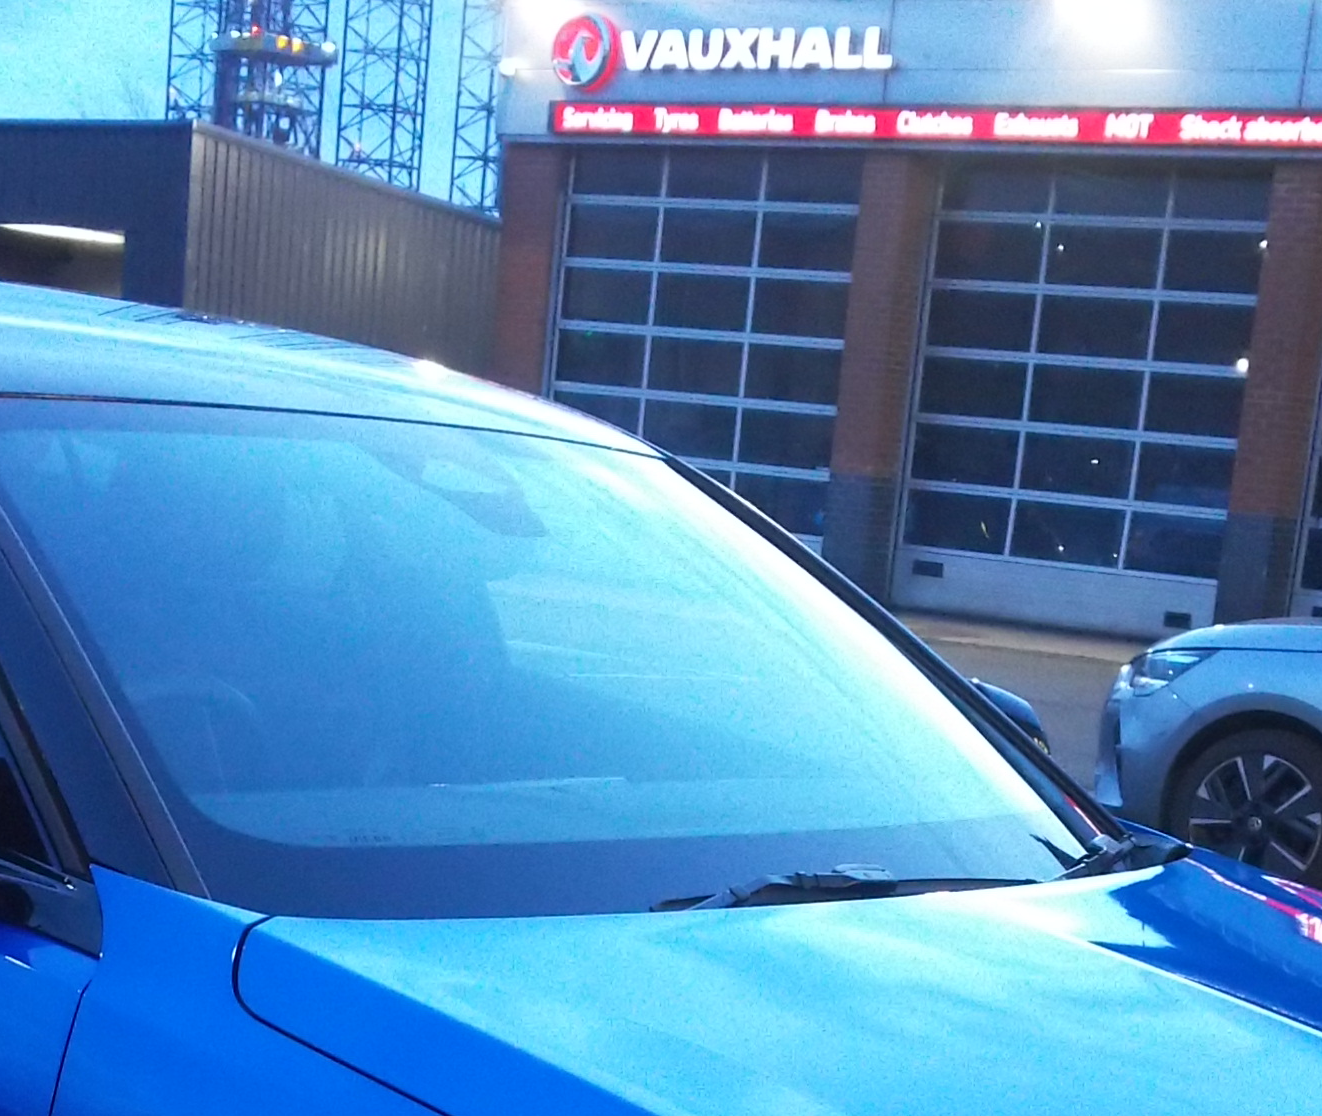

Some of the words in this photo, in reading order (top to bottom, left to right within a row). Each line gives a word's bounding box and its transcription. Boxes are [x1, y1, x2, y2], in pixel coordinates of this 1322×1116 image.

[621, 26, 893, 71] VAUXHALL
[563, 107, 633, 133] Servicing
[654, 107, 699, 133] Tyres
[717, 108, 794, 133] Batteries
[814, 109, 876, 134] Brakes
[897, 110, 973, 135] Clutches
[1105, 113, 1154, 139] MOT
[1180, 114, 1243, 140] Shock
